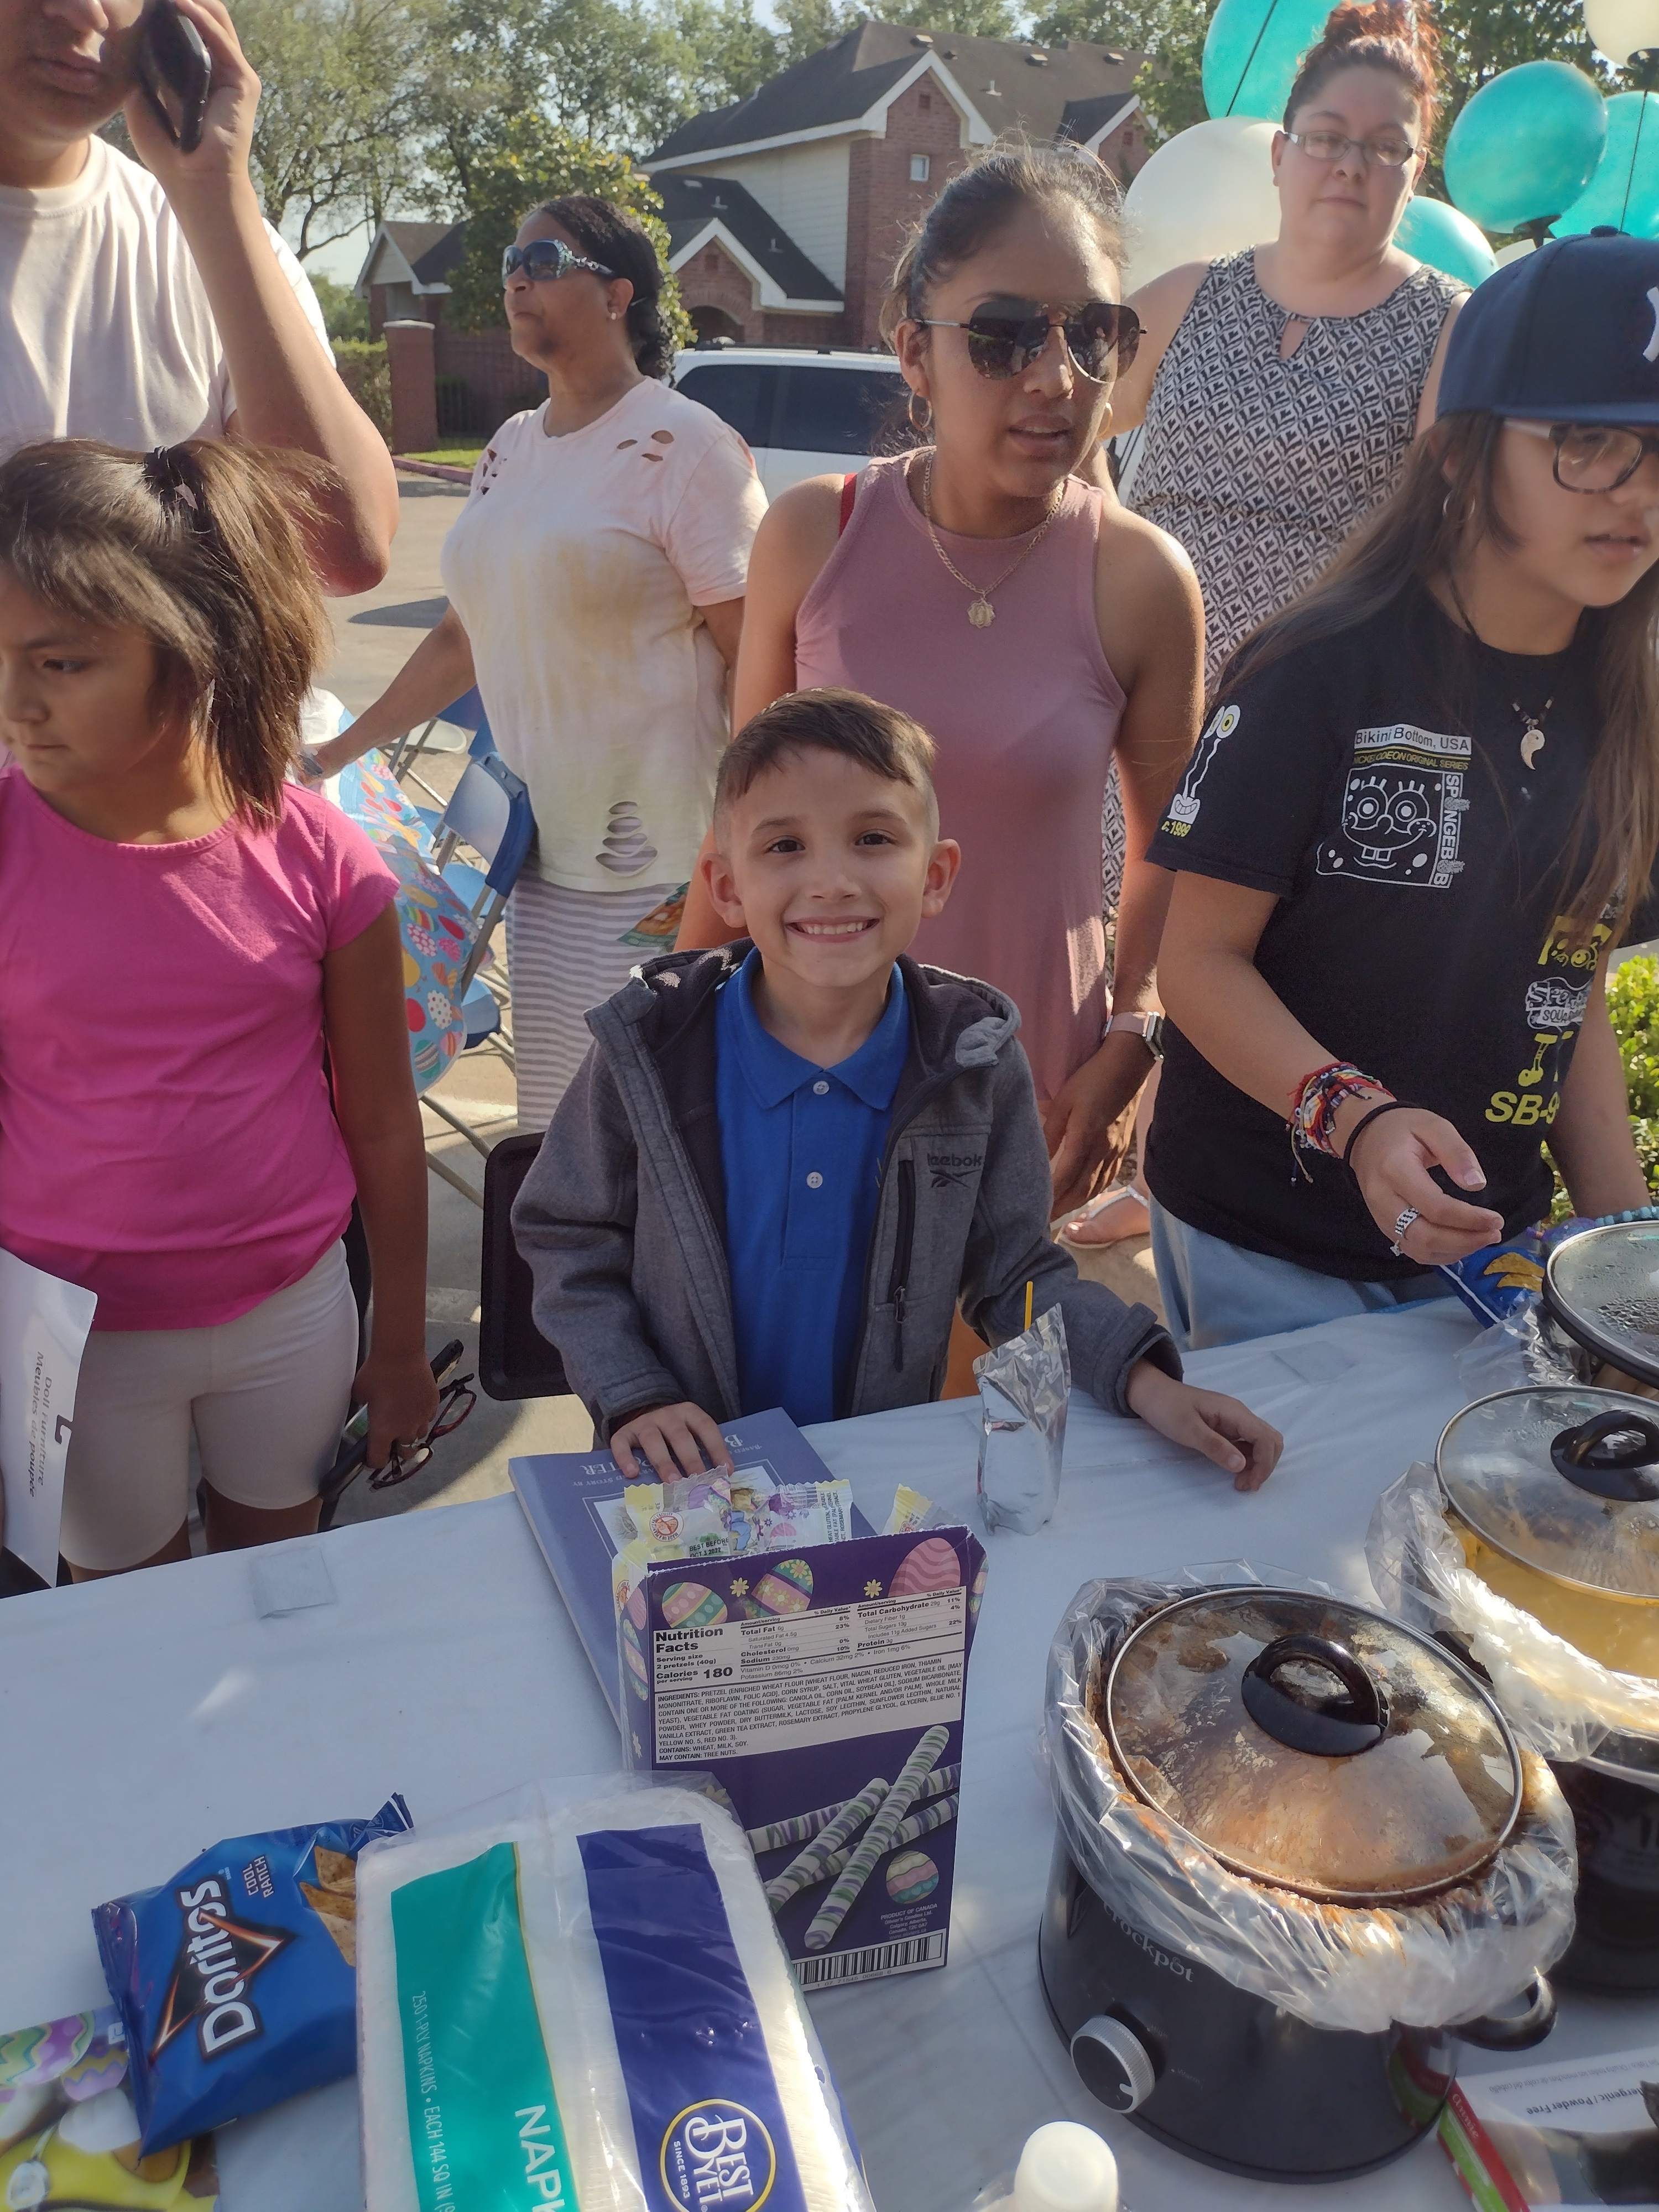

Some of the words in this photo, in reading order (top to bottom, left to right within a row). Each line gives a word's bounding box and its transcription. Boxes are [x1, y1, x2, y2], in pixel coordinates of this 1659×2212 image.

[1355, 728, 1392, 744] Bikini
[1394, 727, 1436, 750] Bottom,
[1440, 737, 1469, 751] USA
[1407, 754, 1437, 767] ORIGINAL
[1439, 760, 1469, 770] SERIES
[32, 1351, 44, 1416] Meubles
[43, 1376, 52, 1408] Doll
[31, 1420, 38, 1439] de
[38, 1412, 48, 1486] Furniture
[586, 1477, 614, 1486] STORY
[706, 1537, 729, 1548] BEFORE
[857, 1609, 877, 1618] Total
[879, 1602, 929, 1614] Carbohydrate
[858, 1599, 896, 1608] Amount/serving
[740, 1617, 780, 1626] Amount/serving
[655, 1627, 723, 1642] Nutrition
[740, 1627, 761, 1636] Total
[748, 1634, 774, 1642] Saturated
[656, 1641, 698, 1653] Facts
[740, 1646, 786, 1657] Cholesterol
[857, 1639, 884, 1648] Protein
[656, 1670, 698, 1679] Calories
[703, 1666, 733, 1679] 180
[663, 1661, 695, 1670] pretzels
[696, 1658, 716, 1666] (40g)
[658, 1692, 700, 1702] INGREDIENTS:
[701, 1688, 727, 1697] PRETZEL
[728, 1685, 760, 1695] (ENRICHED
[805, 1676, 827, 1686] [WHEAT
[829, 1673, 849, 1682] FLOUR,
[851, 1670, 872, 1678] NIACIN,
[873, 1665, 900, 1674] REDUCED
[918, 1657, 942, 1667] THIAMIN
[242, 1864, 259, 1896] COOL
[254, 1856, 274, 1898] RANCH
[880, 1910, 906, 1920] PRODUCT
[915, 1903, 937, 1912] CANADA
[182, 1879, 258, 2054] Doritos
[412, 1990, 427, 2015] 250
[415, 2015, 430, 2043] 1-PLY
[418, 2043, 437, 2094] NAPKINS
[1526, 2104, 1551, 2114] Free
[1552, 2096, 1593, 2110] Powder
[424, 2105, 443, 2139] EACH
[696, 2114, 754, 2198] BEST
[432, 2163, 450, 2183] SQ
[673, 2140, 685, 2172] SINCE
[680, 2173, 691, 2199] 1893
[692, 2158, 723, 2204] YET
[435, 2184, 453, 2200] IN
